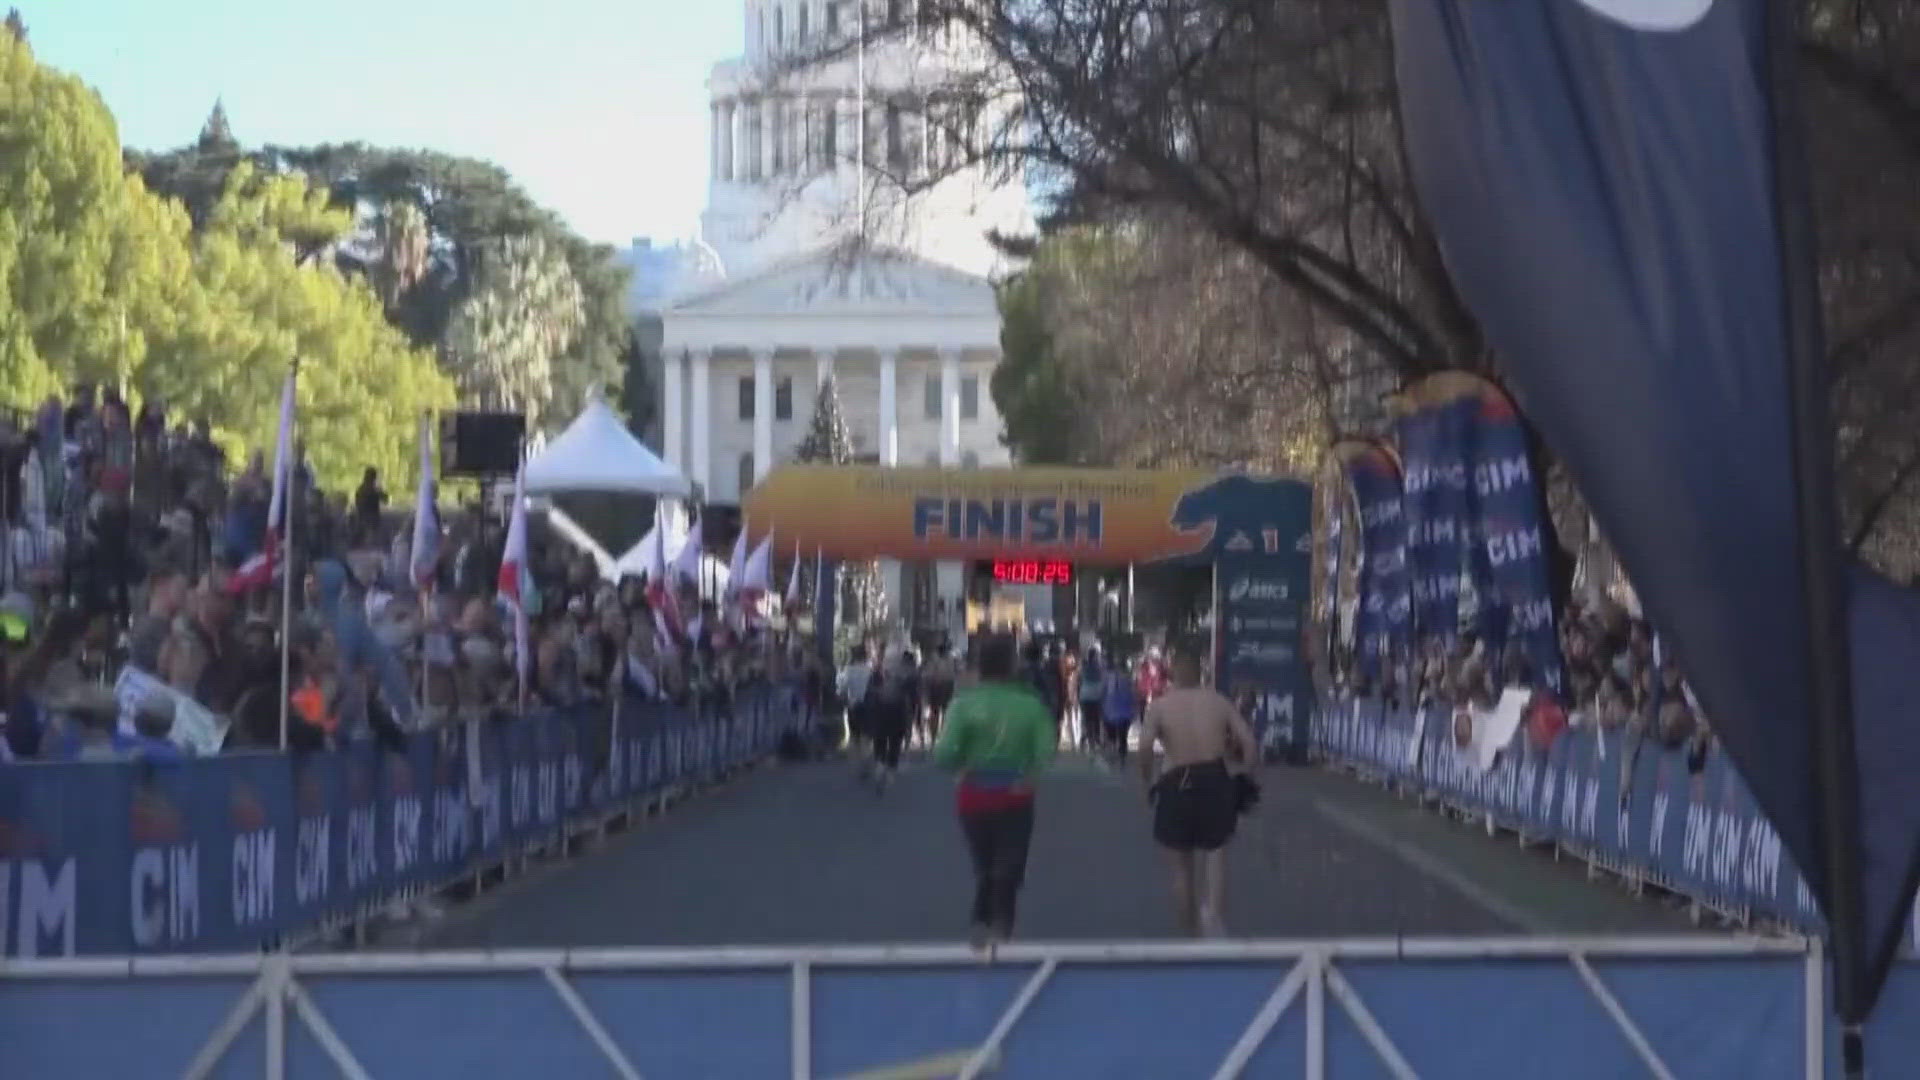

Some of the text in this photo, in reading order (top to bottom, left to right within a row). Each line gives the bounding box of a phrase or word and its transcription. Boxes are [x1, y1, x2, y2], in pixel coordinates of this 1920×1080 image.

[1475, 453, 1530, 497] CIM
[914, 498, 1103, 544] FINISH
[1487, 524, 1542, 568] CIM
[994, 560, 1069, 584] 5:00:25
[232, 827, 276, 927] CIM
[1713, 807, 1742, 891] CIM
[1744, 816, 1781, 901] CIM
[0, 855, 76, 958] IM
[131, 841, 199, 948] CIM
